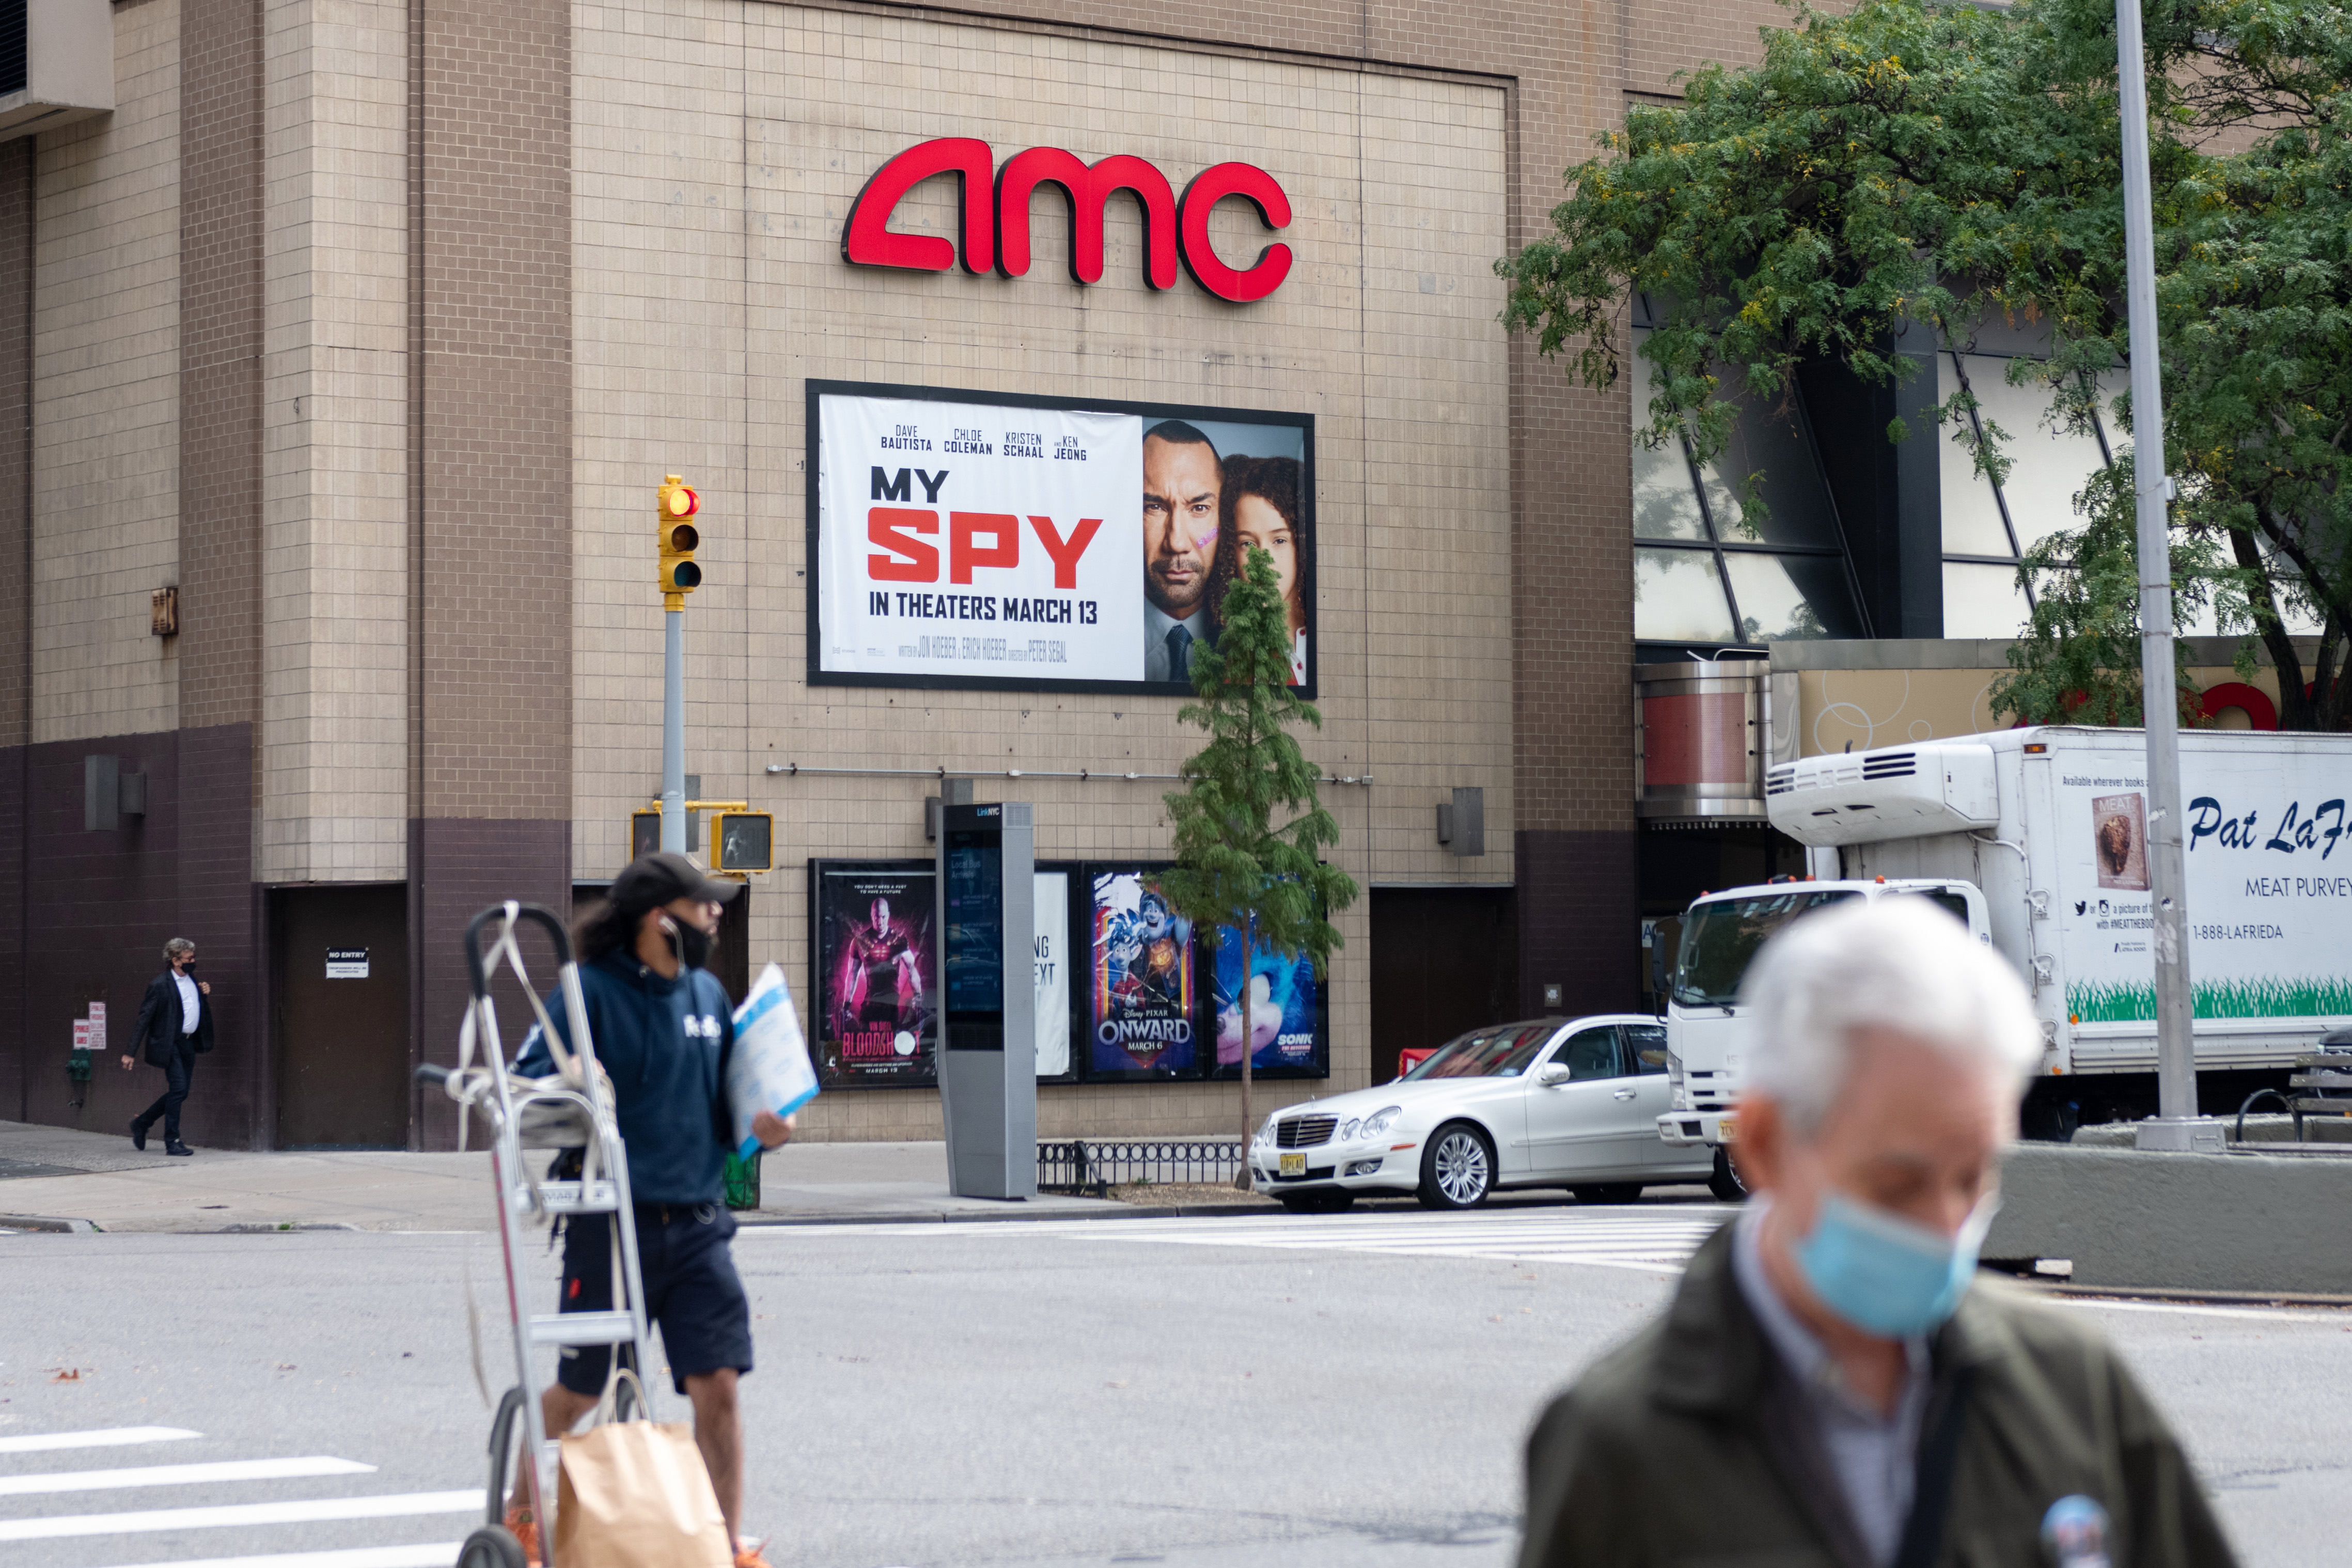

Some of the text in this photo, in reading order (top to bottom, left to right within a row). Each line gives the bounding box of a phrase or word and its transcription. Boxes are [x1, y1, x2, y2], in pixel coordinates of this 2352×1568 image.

[896, 425, 917, 437] DAVE
[954, 429, 982, 442] CHLOE
[882, 436, 932, 451] BAUTISTA
[1006, 432, 1041, 445] KRISTEN
[1063, 435, 1078, 448] KEN
[945, 441, 992, 454] COLEMAN
[1004, 445, 1043, 458] SCHAAL
[1054, 448, 1086, 461] JEONG
[871, 466, 950, 503] MY
[868, 507, 1104, 589] SPY
[870, 591, 1097, 624] IN THEATERS MARCH 13
[898, 646, 912, 657] WRITTEN
[913, 646, 917, 657] BY
[918, 635, 930, 658] JON
[932, 636, 956, 659] HOEBER
[963, 637, 980, 660] ERICH
[983, 638, 1006, 661] HOEBER
[1008, 650, 1023, 662] DIRECTED
[1024, 650, 1028, 662] BY
[1029, 639, 1047, 662] PETER
[1048, 640, 1067, 663] SEGAL
[2063, 776, 2091, 786] Available
[2093, 777, 2123, 787] wherever
[2124, 777, 2144, 787] books
[2098, 796, 2132, 812] MEAT
[977, 807, 999, 816] LinkNYC
[2188, 796, 2257, 852] Pat
[951, 860, 967, 869] Local
[2246, 877, 2290, 897] MEAT
[2089, 905, 2096, 914] or
[2119, 904, 2140, 915] picture
[2142, 904, 2149, 914] of
[2096, 919, 2154, 929] with #MEATTHEBOO
[2193, 924, 2283, 939] 1-888-LAFRIEDA
[1122, 1008, 1144, 1020] Disney
[1099, 1018, 1190, 1045] ONWARD
[1278, 1033, 1313, 1045] SONIC
[1128, 1041, 1163, 1052] MARCH 6
